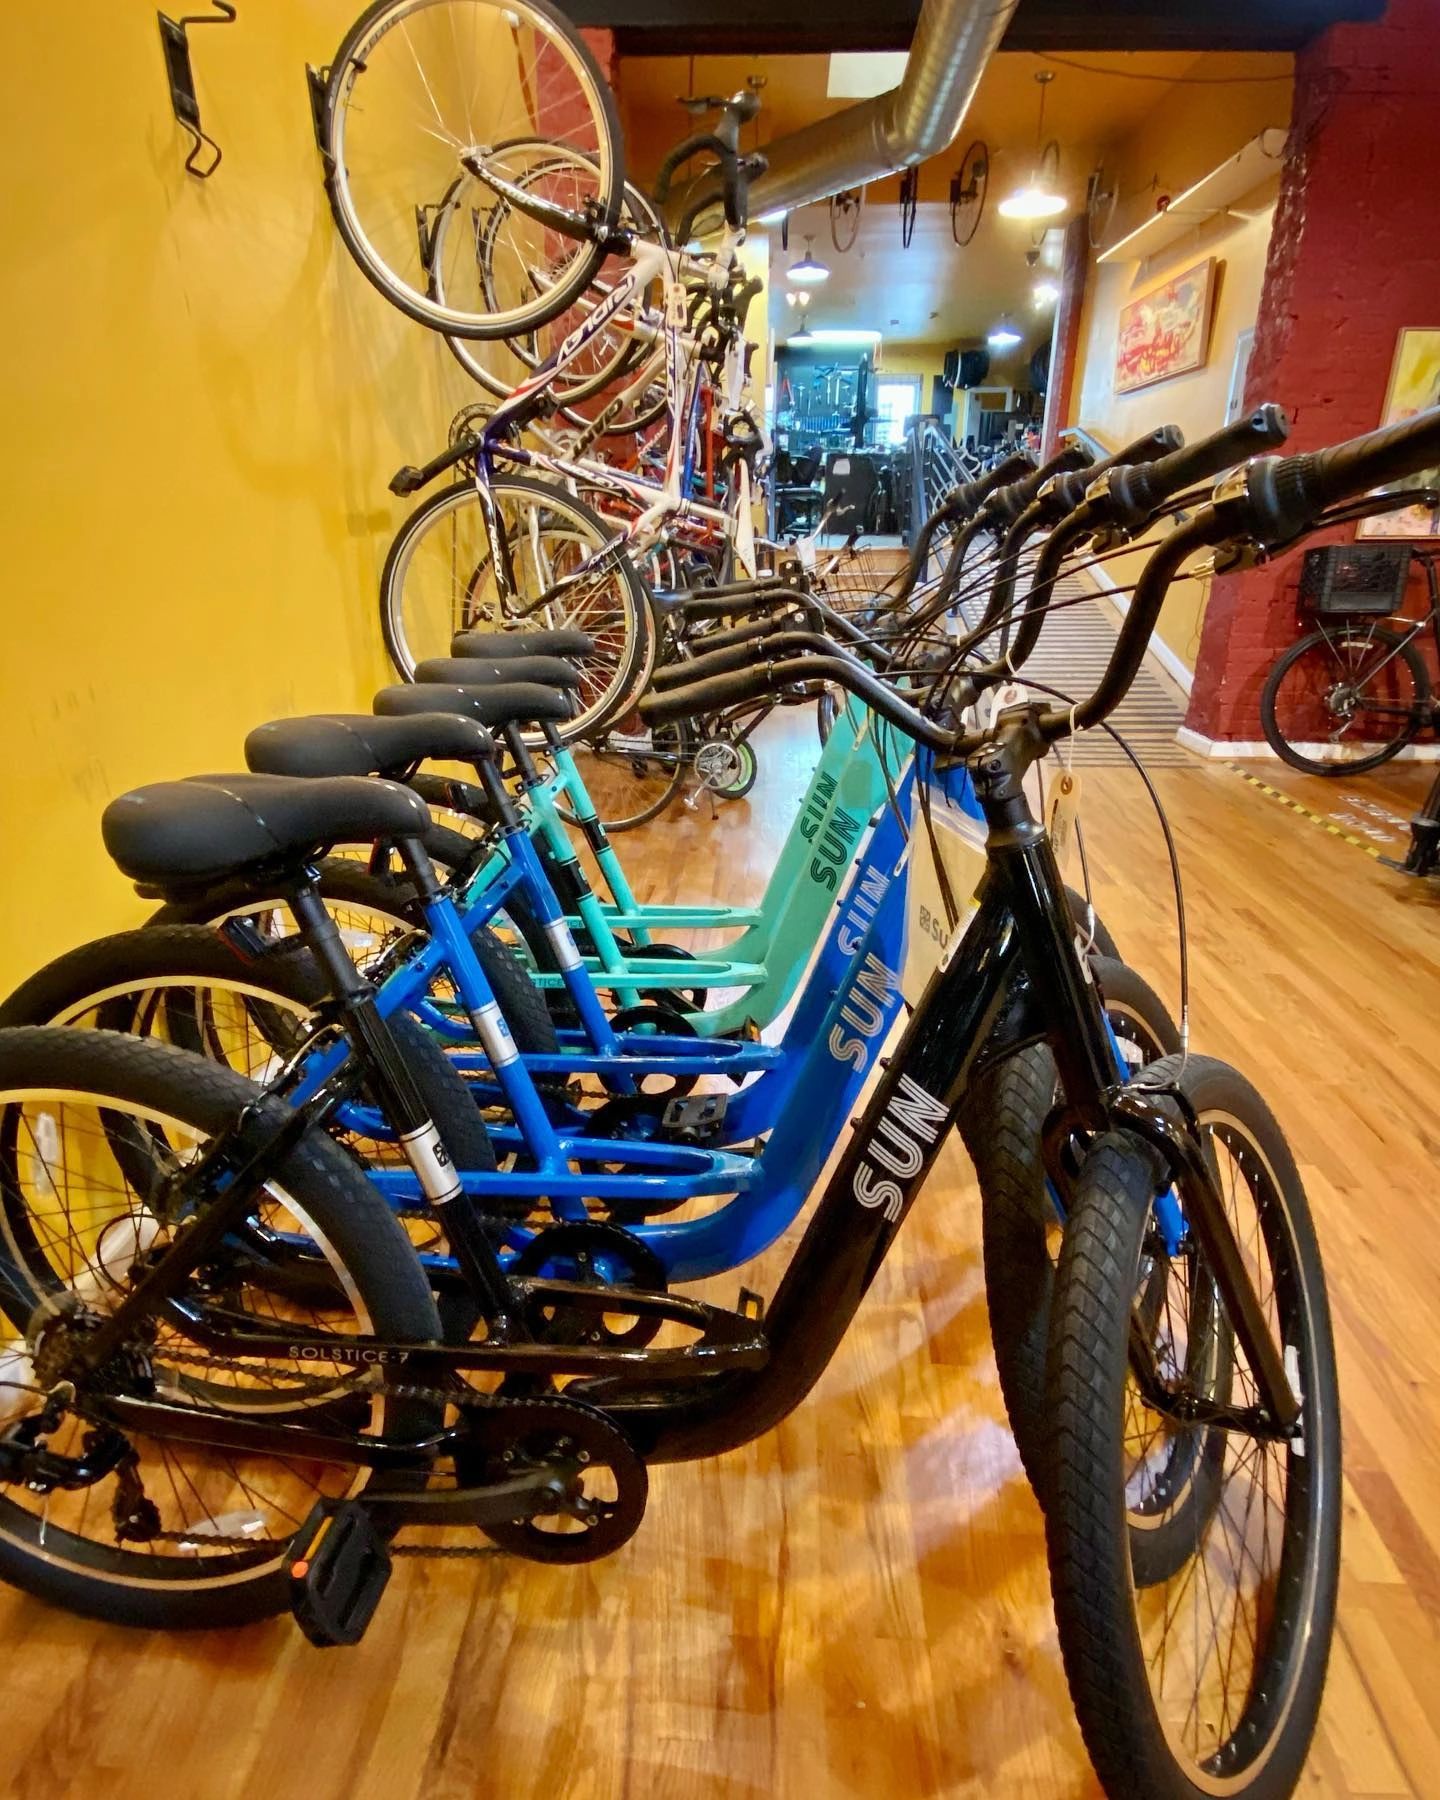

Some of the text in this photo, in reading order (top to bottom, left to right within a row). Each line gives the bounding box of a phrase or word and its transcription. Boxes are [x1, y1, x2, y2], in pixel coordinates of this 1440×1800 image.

[556, 273, 635, 368] RIDLEY
[572, 398, 624, 461] GIANT
[810, 806, 862, 892] SUN
[829, 951, 900, 1074] SUN
[853, 1072, 951, 1224] SUN
